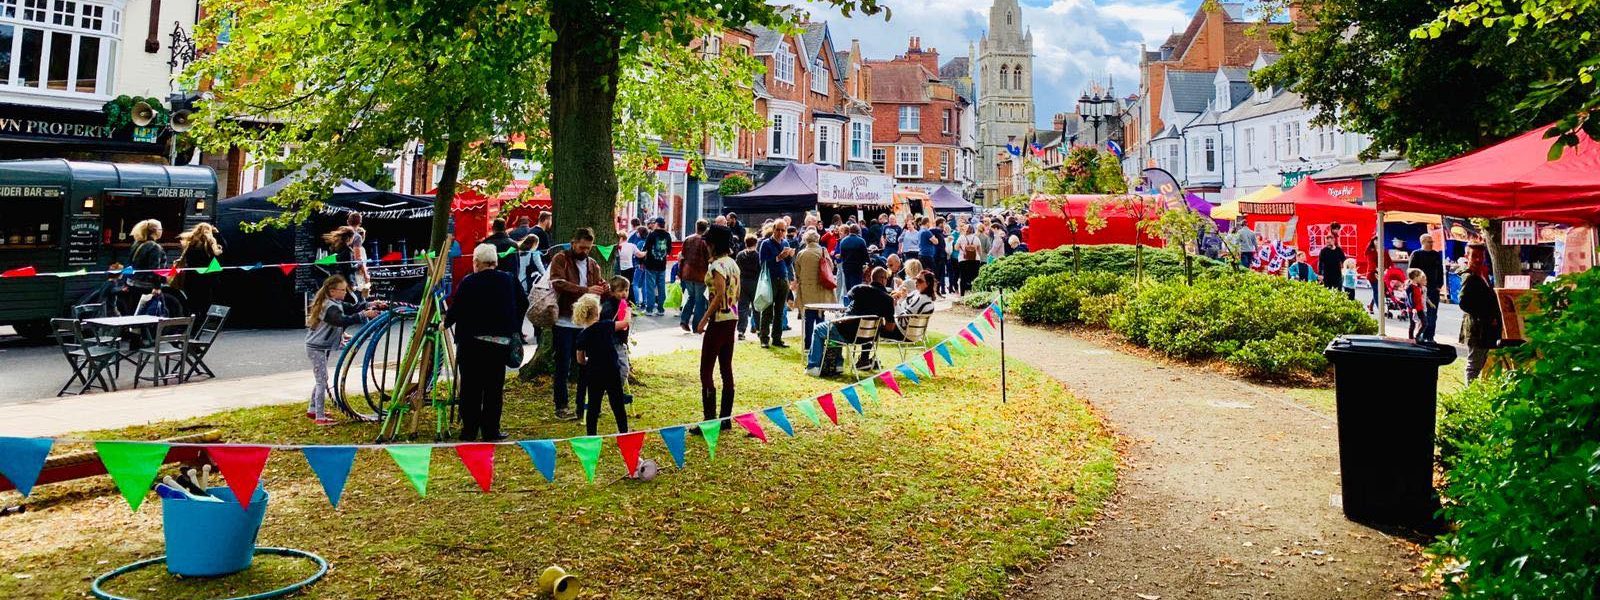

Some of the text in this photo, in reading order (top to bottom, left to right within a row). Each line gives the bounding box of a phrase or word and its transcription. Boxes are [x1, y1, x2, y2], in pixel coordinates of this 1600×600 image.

[26, 120, 116, 139] PROPERTY
[24, 187, 42, 197] BAR
[157, 188, 178, 197] CIDER
[179, 189, 194, 198] BAR
[832, 185, 854, 200] British
